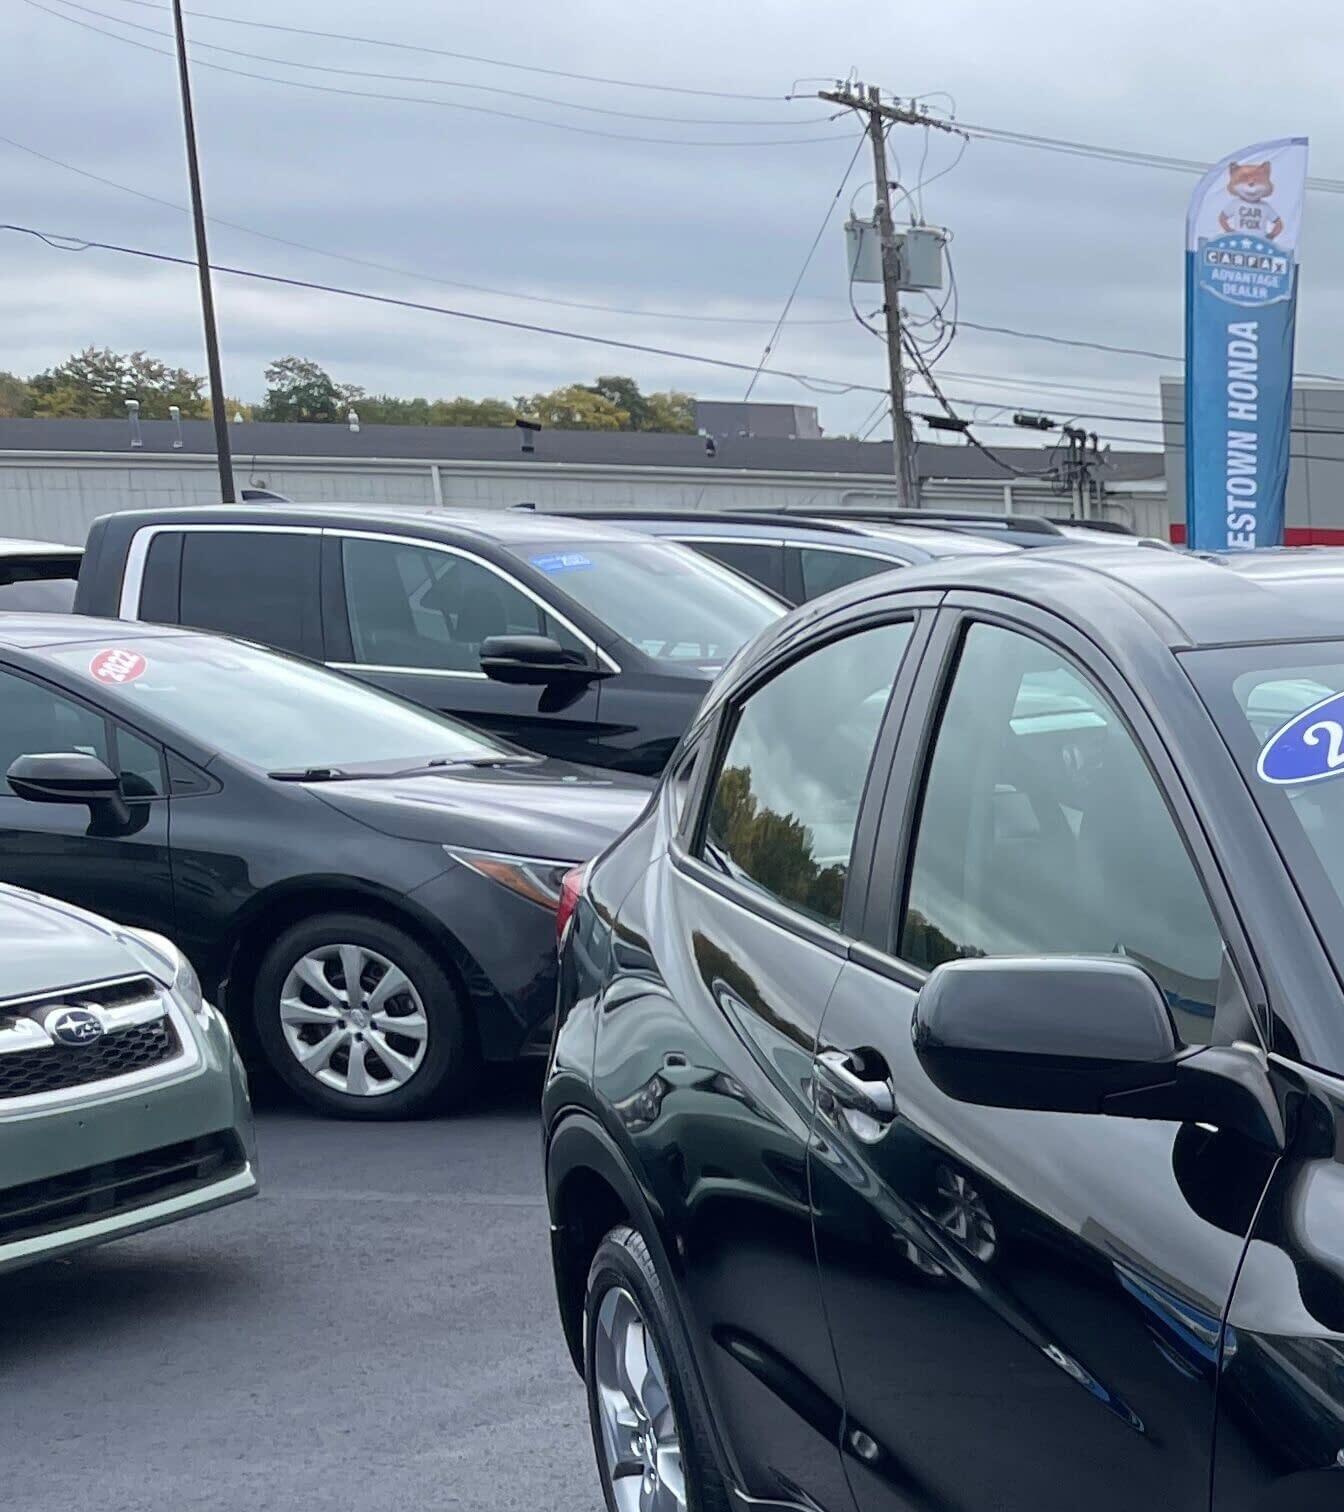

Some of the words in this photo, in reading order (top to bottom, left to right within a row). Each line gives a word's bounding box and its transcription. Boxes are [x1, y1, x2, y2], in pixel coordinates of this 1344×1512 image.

[1239, 206, 1262, 218] CAR
[1240, 219, 1260, 230] FOX
[1207, 250, 1287, 274] CARFAX
[1211, 267, 1279, 289] ADVANTAGE
[1222, 282, 1268, 298] DEALER
[1227, 321, 1259, 421] HONDA
